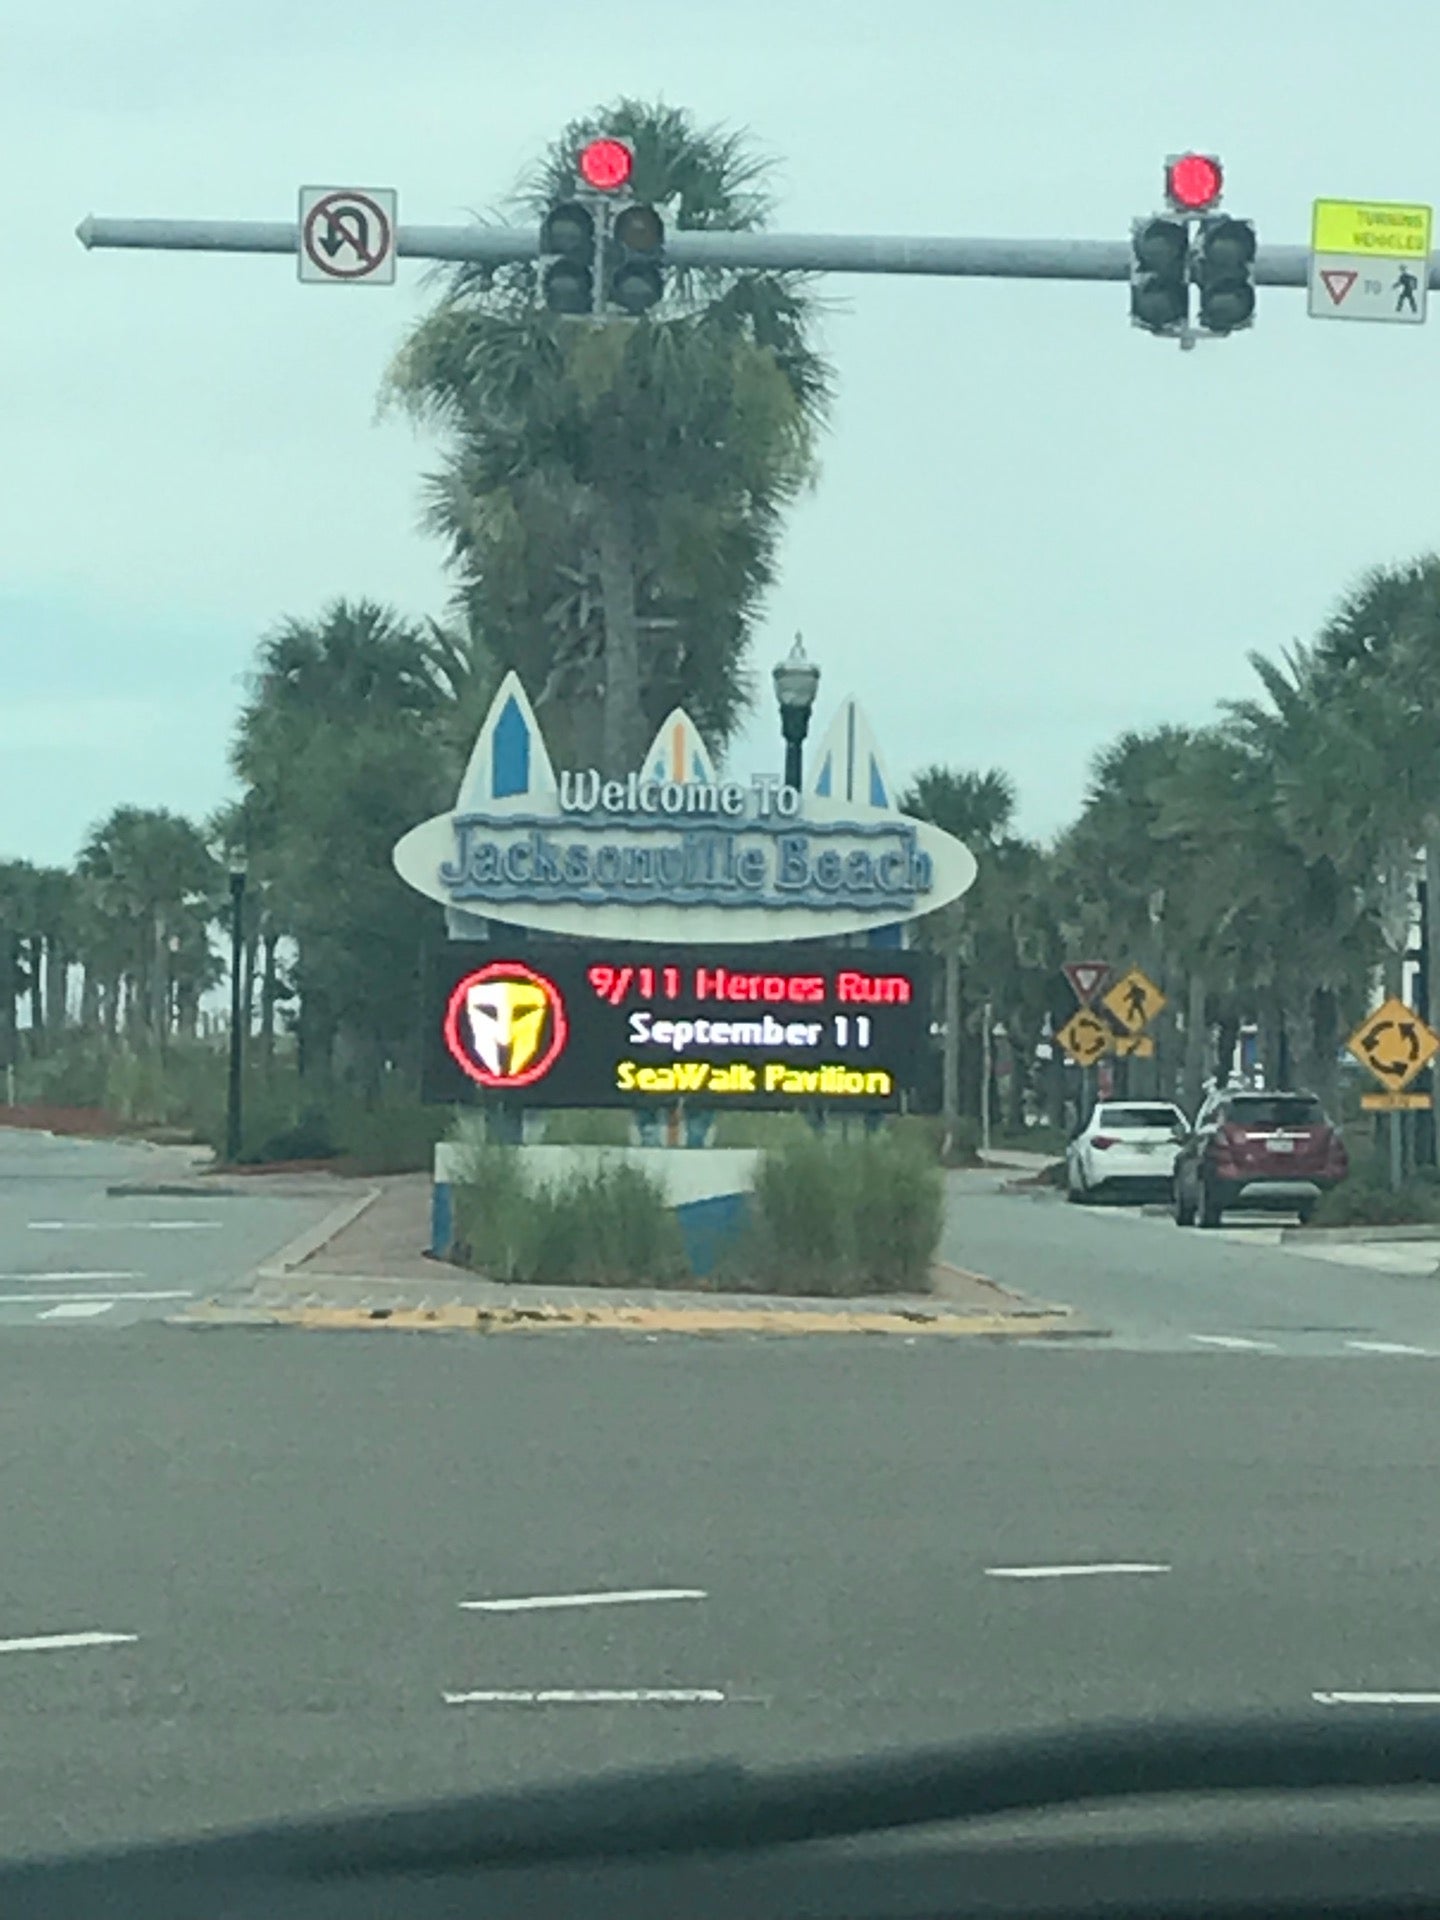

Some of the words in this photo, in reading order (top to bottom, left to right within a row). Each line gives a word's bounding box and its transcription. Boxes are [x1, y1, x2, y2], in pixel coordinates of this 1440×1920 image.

[559, 769, 745, 816] Welcome
[751, 773, 800, 817] To
[440, 824, 766, 892] Jacksonville
[773, 830, 934, 894] Beach
[586, 967, 680, 1006] 9/11
[696, 968, 825, 1003] Heroes
[837, 971, 912, 1004] Run
[629, 1012, 823, 1052] September
[833, 1015, 871, 1048] 11
[616, 1062, 756, 1094] SeaWalk
[764, 1063, 892, 1096] Pavilion
